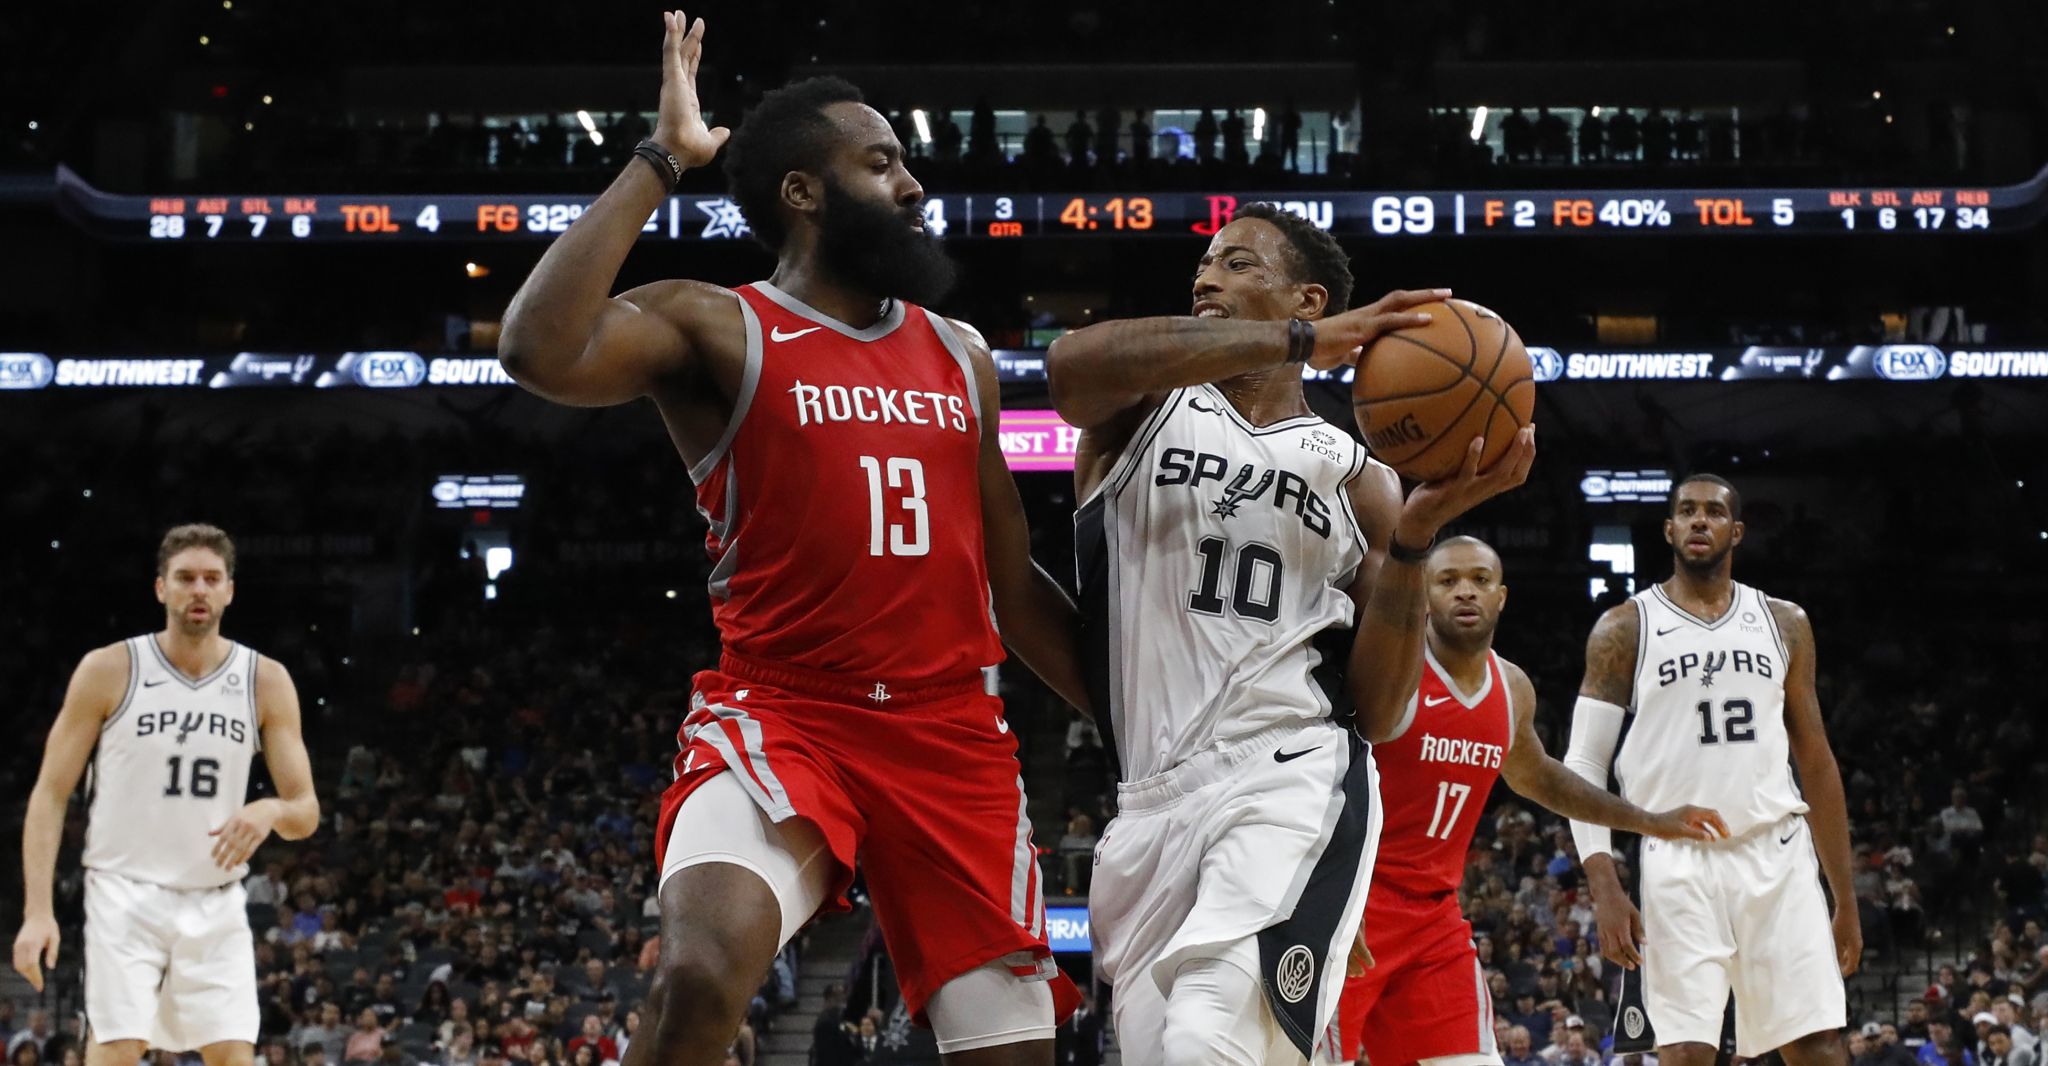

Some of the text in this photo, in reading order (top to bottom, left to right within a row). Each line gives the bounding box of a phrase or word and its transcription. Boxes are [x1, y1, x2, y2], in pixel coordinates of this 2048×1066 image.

[196, 198, 228, 214] AST
[241, 198, 272, 214] STL
[995, 197, 1014, 220] 3
[1060, 197, 1153, 230] 4:13
[1484, 198, 1795, 227] F 2 FG 40% TOL 5
[1829, 191, 1861, 206] BLK
[1871, 191, 1901, 206] STL
[1911, 191, 1942, 206] AST
[150, 215, 311, 238] 28 7 7 6
[340, 204, 399, 232] TOL
[416, 204, 439, 232] 4
[477, 204, 519, 232] FG
[988, 221, 1023, 237] QTR
[1371, 196, 1435, 235] 69
[1841, 208, 1990, 229] 1 6 17 34
[55, 359, 204, 386] SOUTHWEST
[1567, 353, 1713, 379] SOUTHWEST
[1890, 351, 2048, 377] FOX SOUTHW
[787, 379, 968, 433] ROCKETS
[1300, 437, 1344, 465] Frost
[860, 455, 931, 557] 13
[1155, 448, 1332, 540] SPURS
[1187, 535, 1286, 627] 10
[1658, 649, 1773, 688] SPURS
[137, 711, 246, 745] SPURS
[1695, 697, 1757, 747] 12
[1420, 732, 1503, 769] ROCKETS
[163, 754, 220, 799] 16
[1426, 781, 1472, 840] 17
